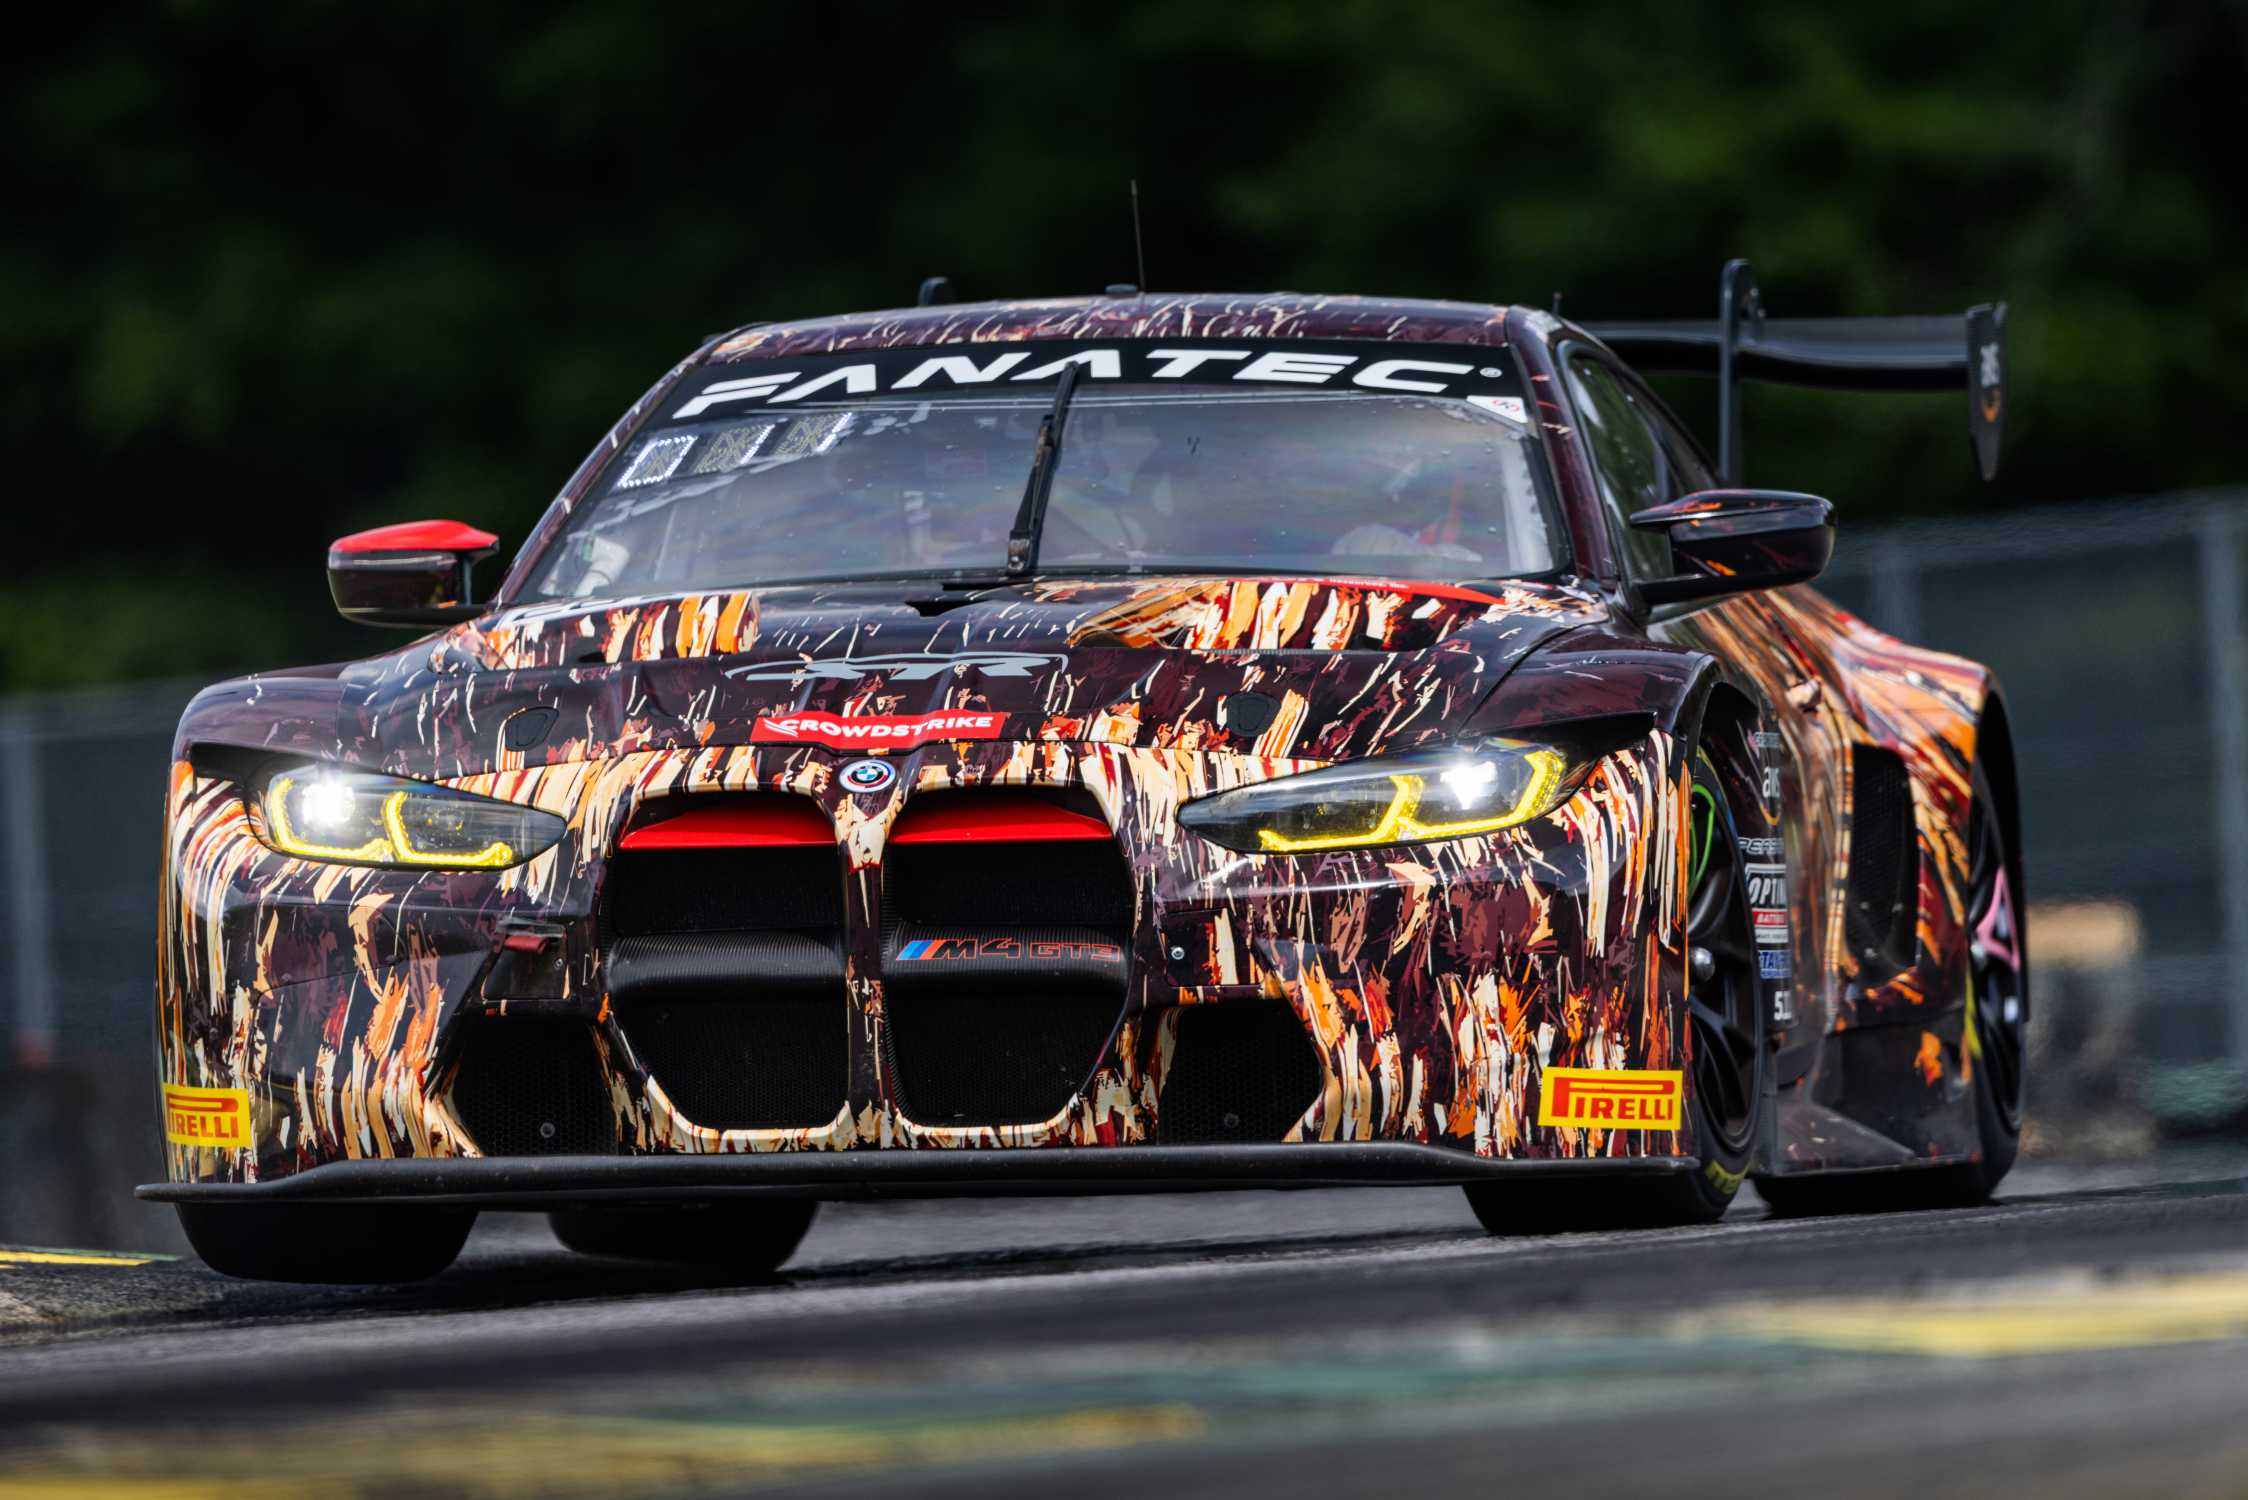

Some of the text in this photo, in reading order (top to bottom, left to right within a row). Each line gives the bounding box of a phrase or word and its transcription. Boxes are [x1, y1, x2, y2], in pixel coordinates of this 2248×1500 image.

[672, 348, 1475, 419] FANATEC
[764, 716, 994, 737] CROWDSTRIKE
[931, 937, 1121, 963] M4 GT3
[165, 1092, 239, 1138] PIRELLI
[1551, 1077, 1675, 1120] PIRELLI
